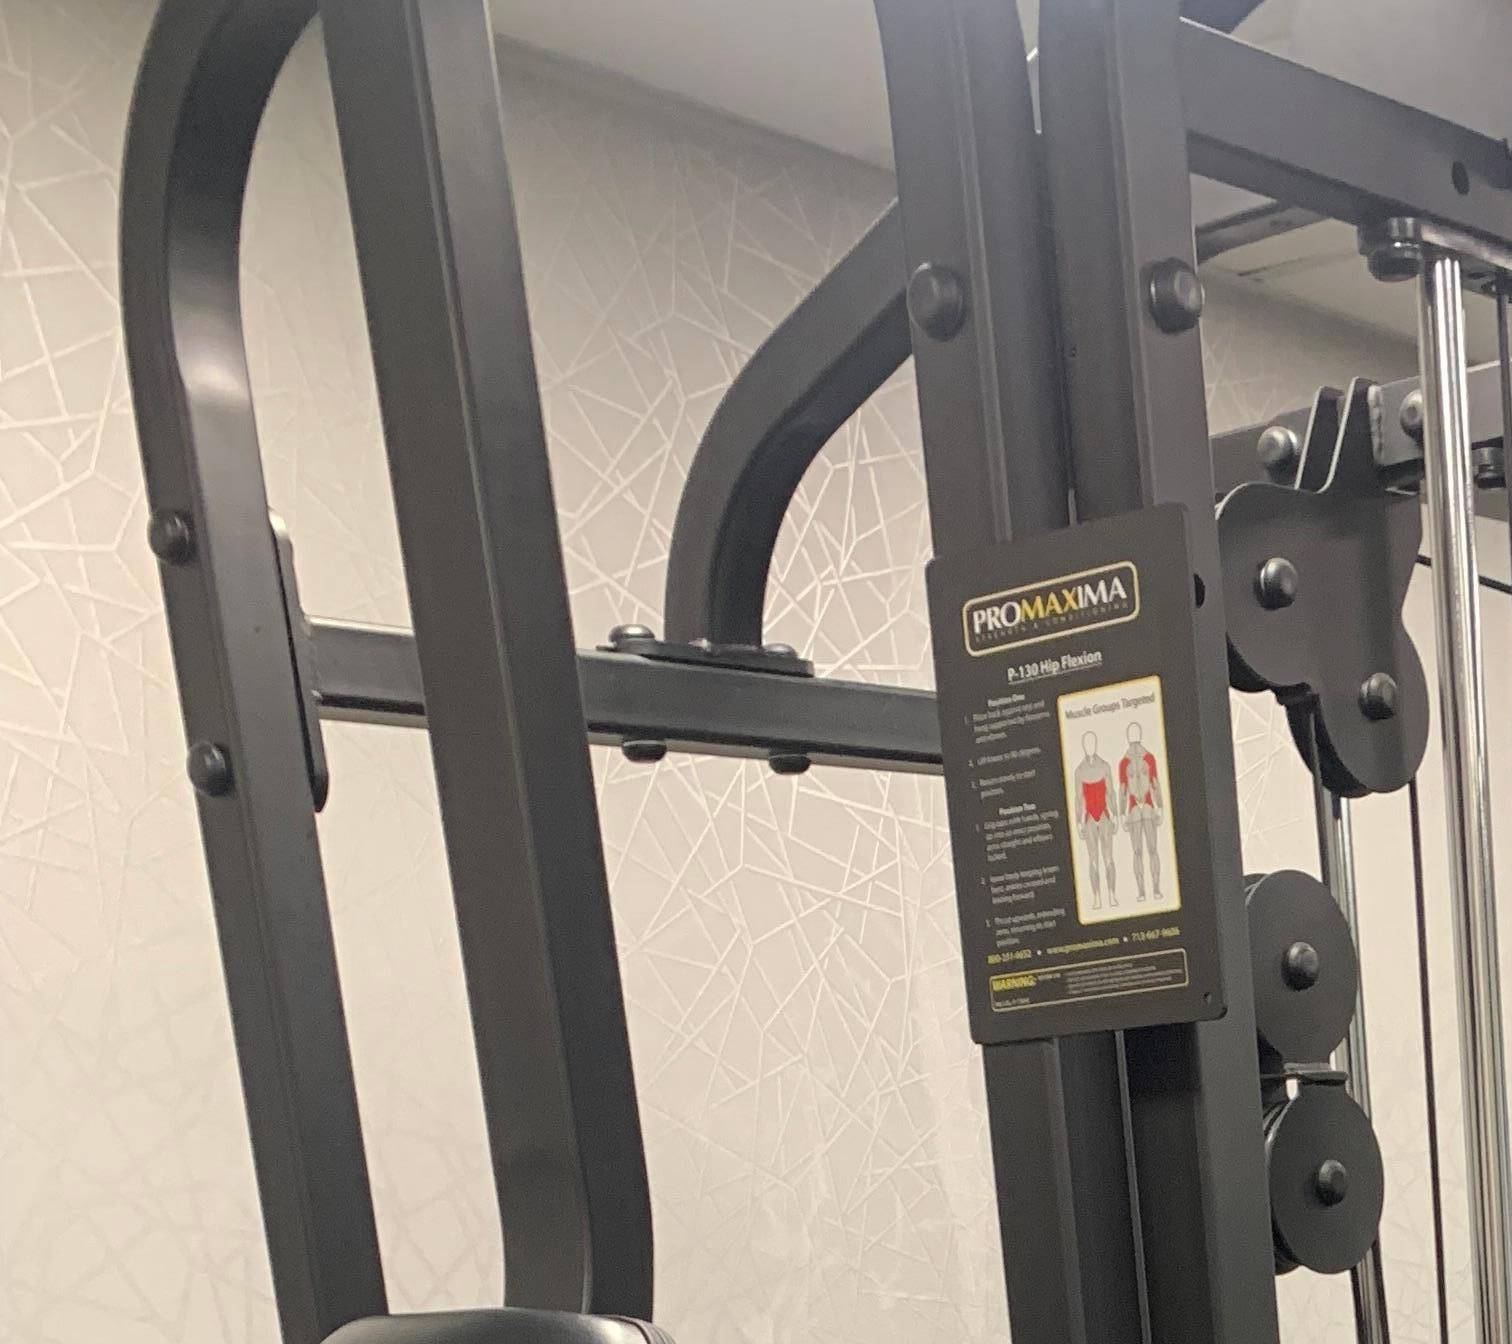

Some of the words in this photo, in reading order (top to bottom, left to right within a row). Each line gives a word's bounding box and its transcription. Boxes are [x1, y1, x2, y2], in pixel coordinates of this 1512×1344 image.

[973, 576, 1127, 634] PROMAXIMA
[1007, 662, 1039, 681] P-130
[1040, 659, 1059, 674] Hip
[1060, 650, 1102, 670] Flexion
[1065, 705, 1091, 719] Muscle
[1092, 702, 1120, 714] Groups
[1120, 692, 1155, 708] Targeted
